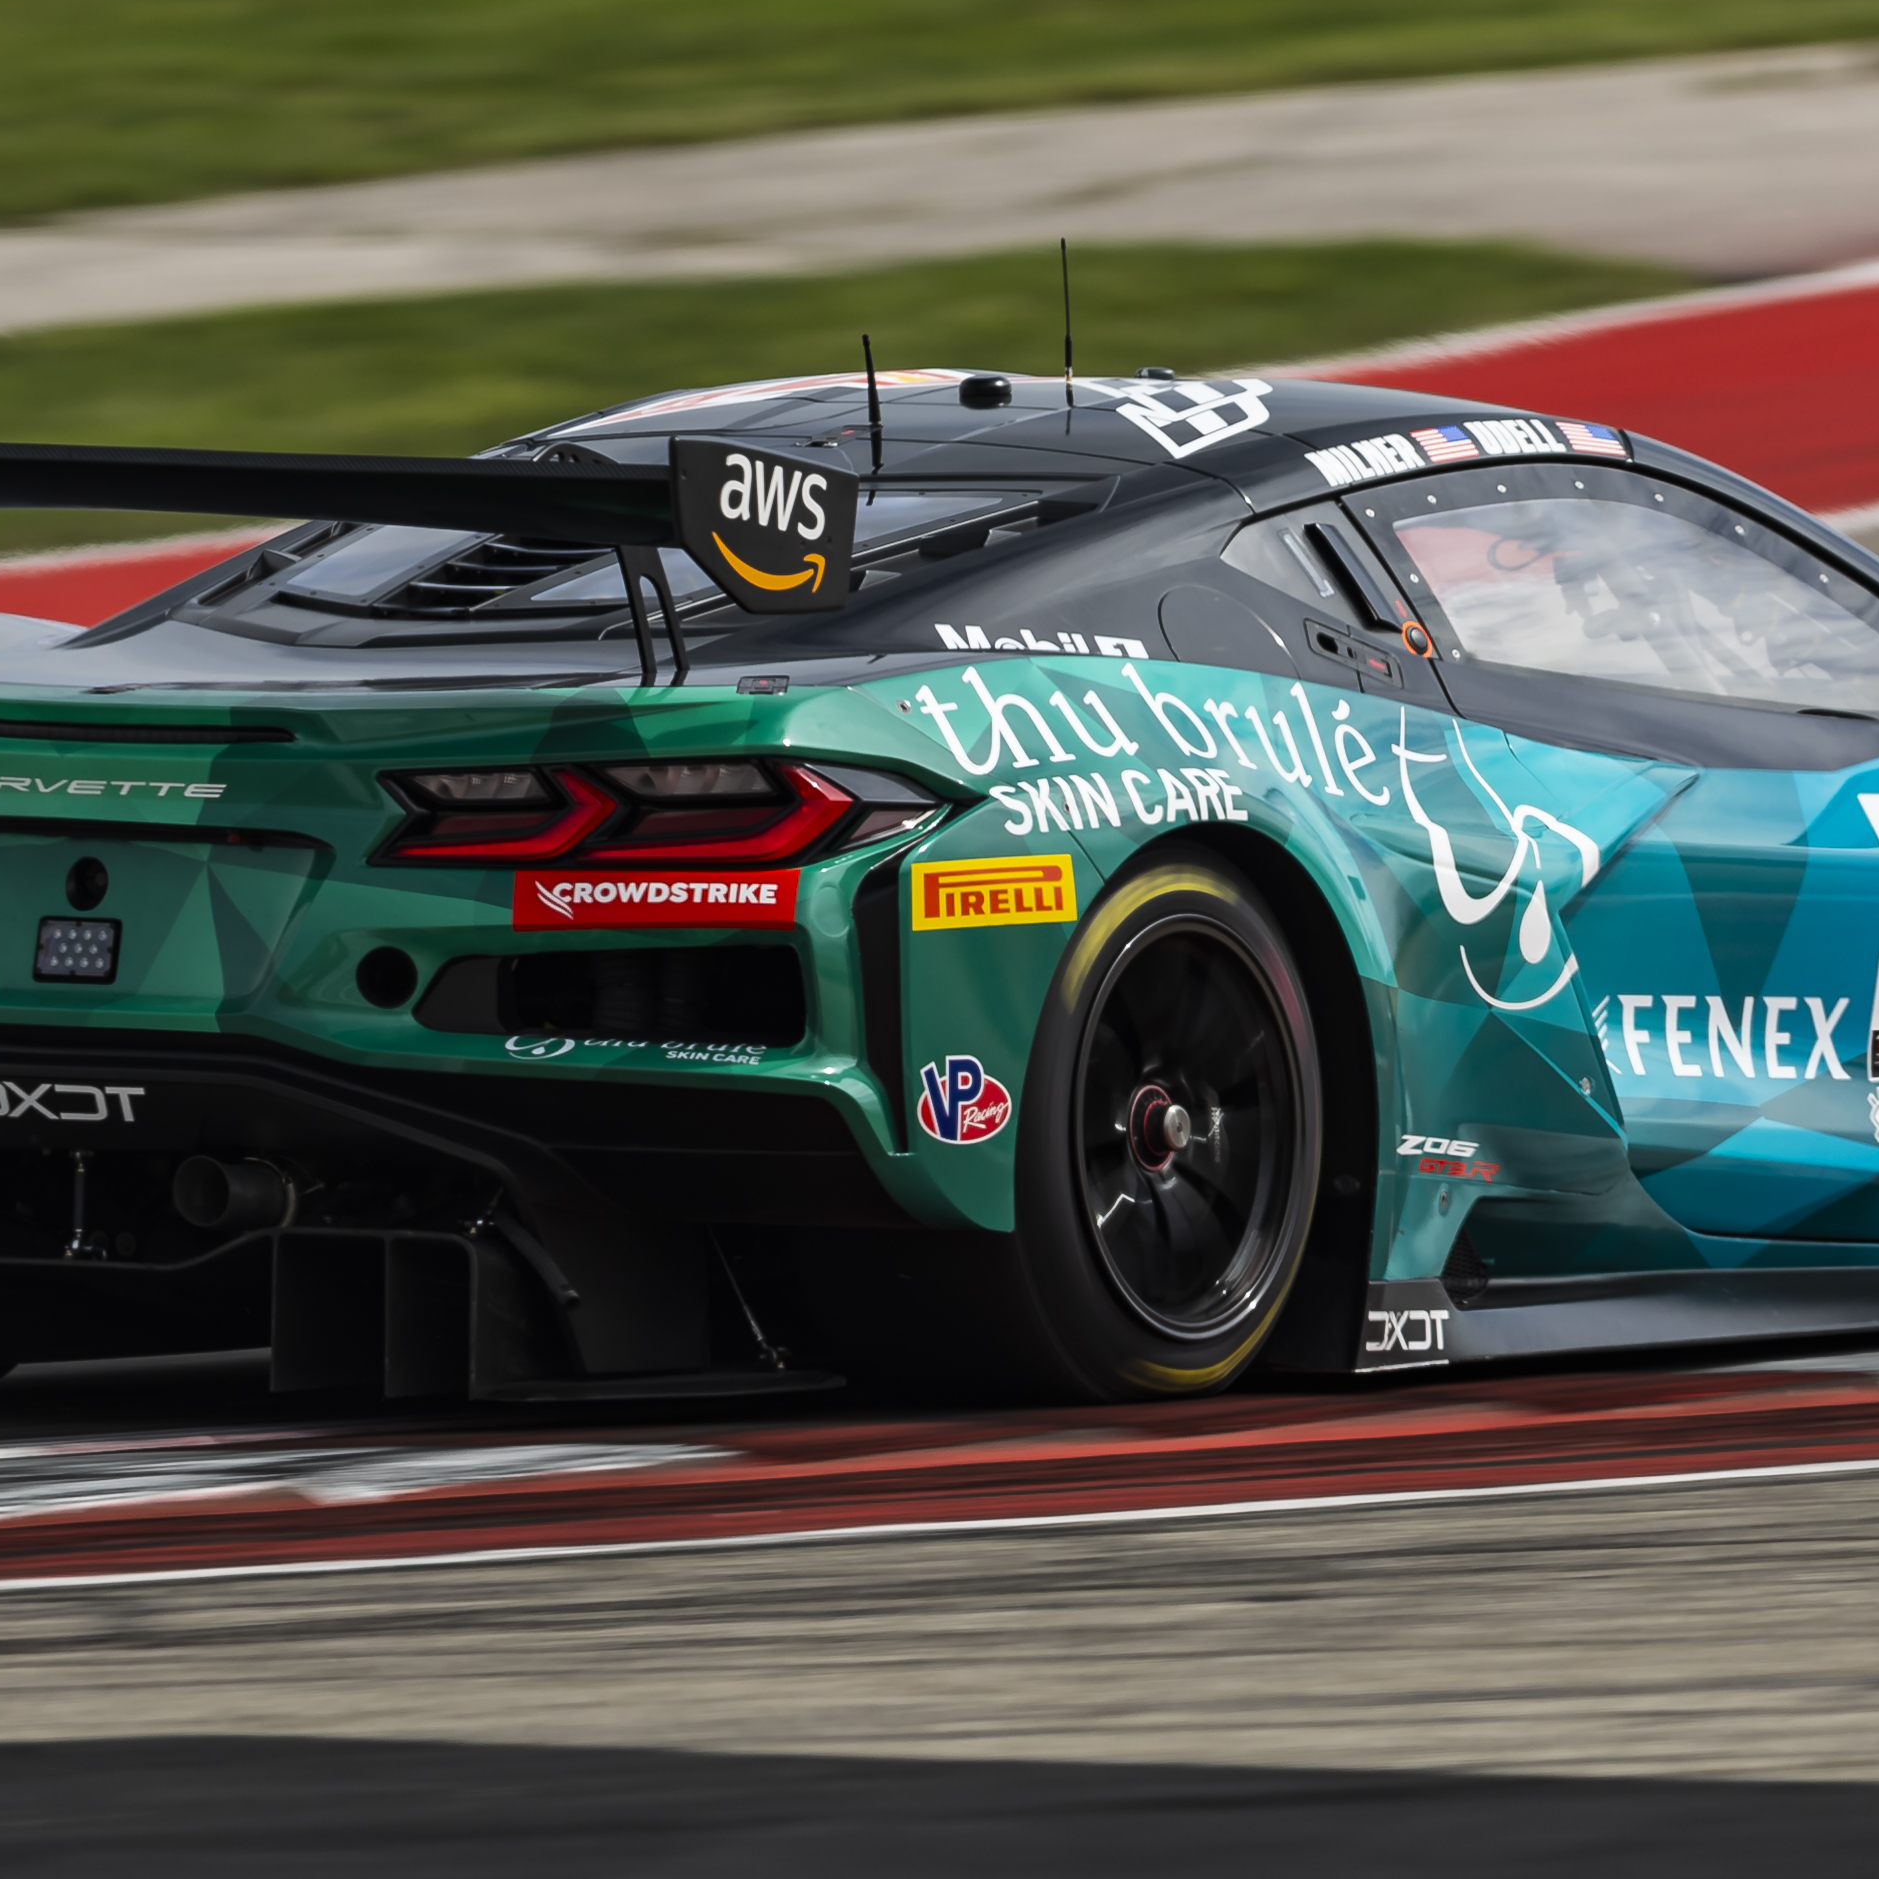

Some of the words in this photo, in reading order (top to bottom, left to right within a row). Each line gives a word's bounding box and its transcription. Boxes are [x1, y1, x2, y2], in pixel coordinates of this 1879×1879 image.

[1304, 433, 1425, 487] MILNER
[1463, 419, 1566, 455] UDELL
[720, 453, 828, 540] aws
[915, 666, 1139, 775] thu
[988, 773, 1121, 835] SKIN
[1121, 768, 1249, 825] CARE
[552, 882, 778, 904] CROWDSTRIKE
[923, 865, 1063, 918] PIRELLI
[665, 1050, 709, 1061] SKIN
[712, 1053, 761, 1065] CARE
[1617, 994, 1851, 1080] FENEX
[920, 1055, 984, 1142] VP
[963, 1101, 1009, 1133] Racing
[1396, 1134, 1480, 1157] Z06
